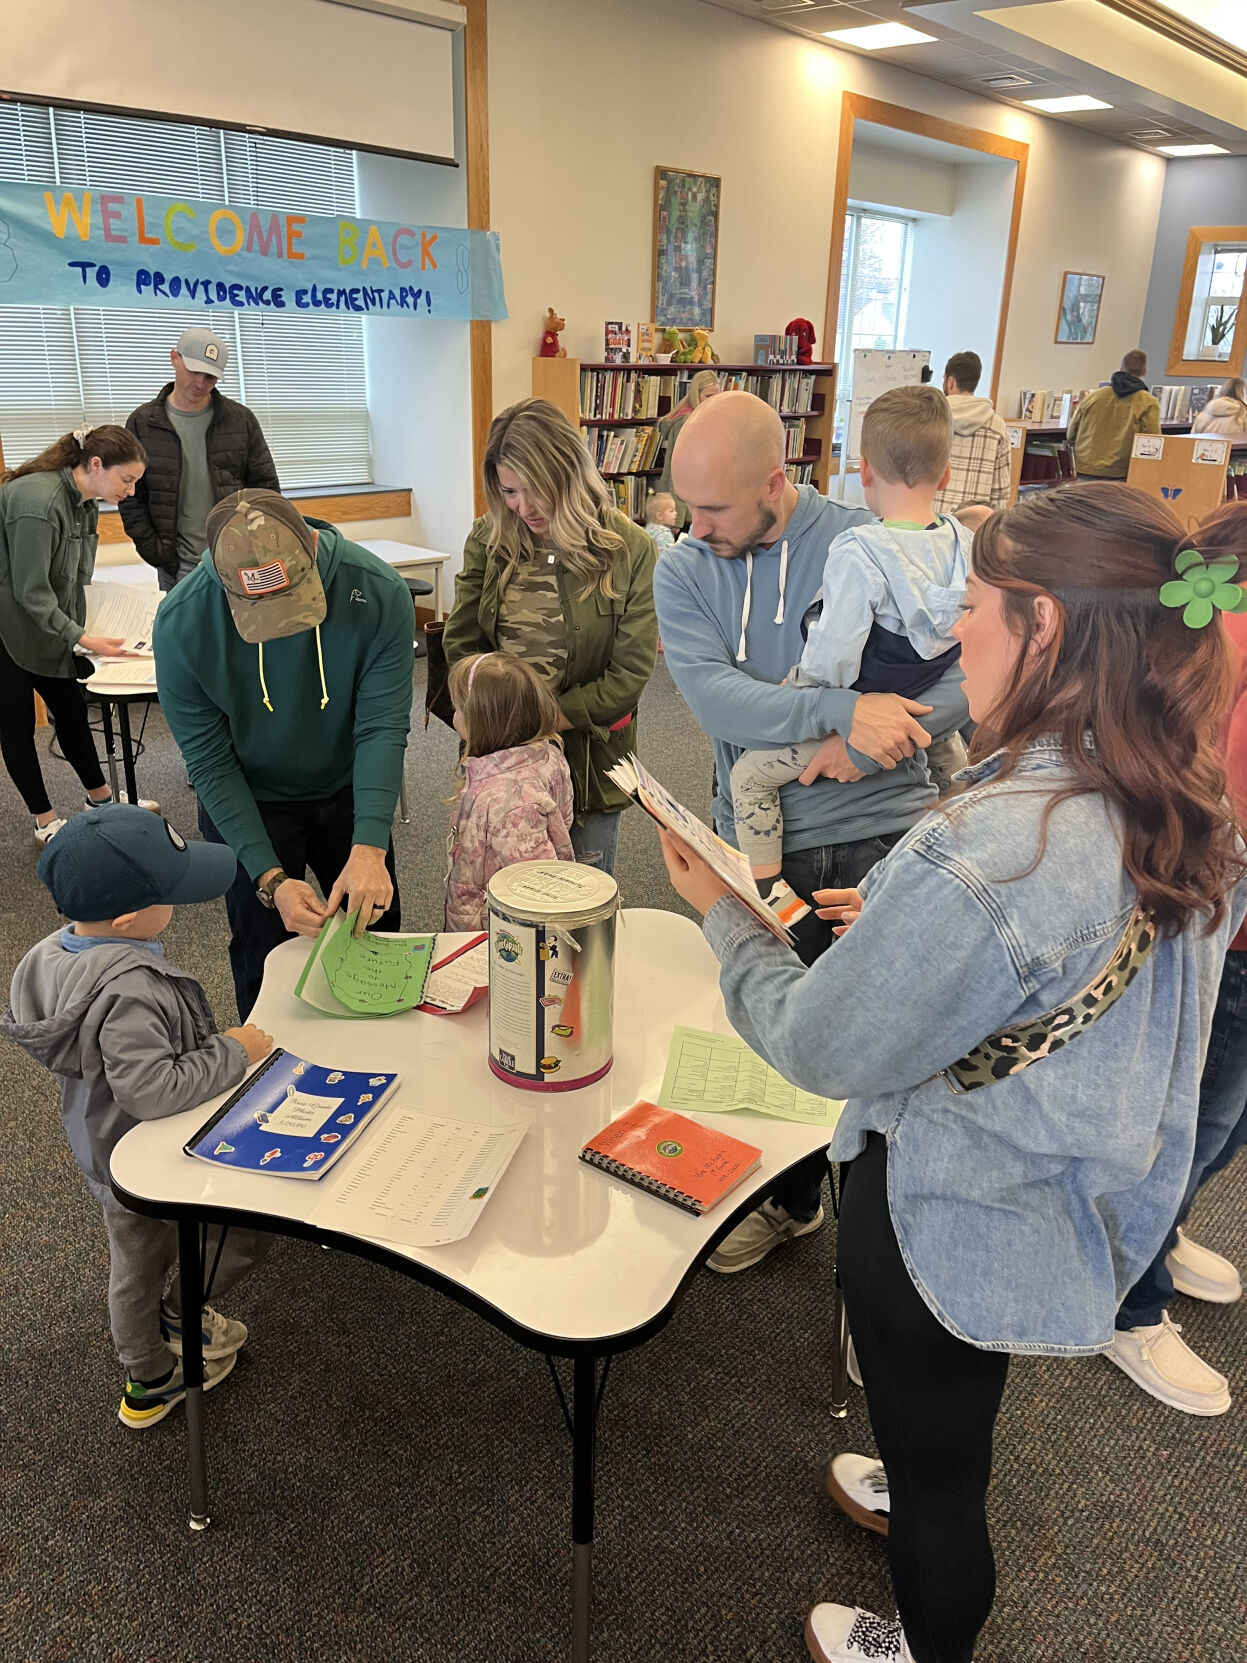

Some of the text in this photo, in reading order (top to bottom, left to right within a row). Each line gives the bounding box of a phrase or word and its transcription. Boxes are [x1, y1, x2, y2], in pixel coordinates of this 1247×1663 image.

[43, 191, 438, 272] WELCOME BACK
[67, 261, 432, 314] TO PROVIDENCE ELEMENTARY!
[359, 952, 400, 967] Future
[366, 966, 382, 974] the
[345, 970, 397, 990] Message
[355, 990, 383, 1000] Our
